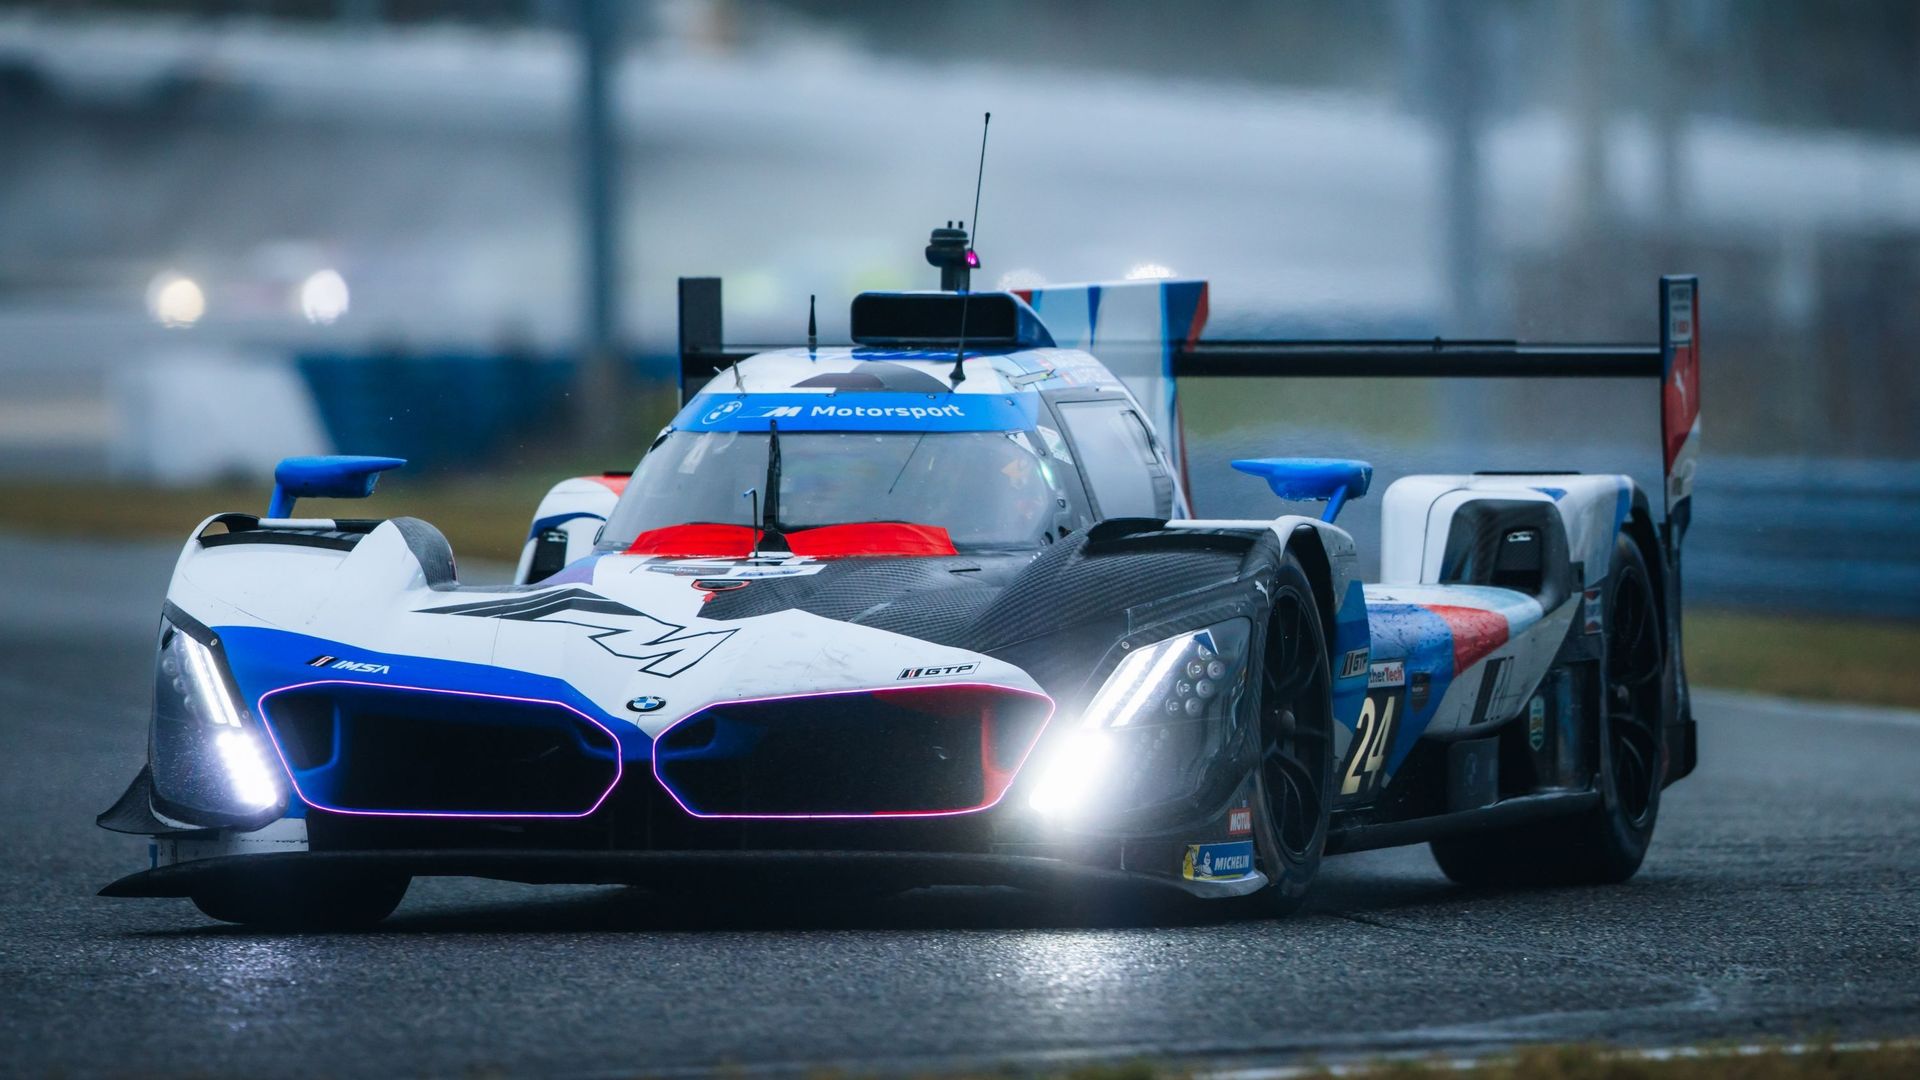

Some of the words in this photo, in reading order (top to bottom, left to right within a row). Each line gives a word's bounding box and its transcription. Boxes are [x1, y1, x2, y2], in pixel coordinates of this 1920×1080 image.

[811, 404, 965, 419] Motorsport
[331, 660, 389, 674] IMSA
[924, 664, 974, 676] GTP
[1353, 653, 1369, 672] GTP
[1341, 695, 1396, 796] 24
[1214, 855, 1250, 871] MICHELIN
